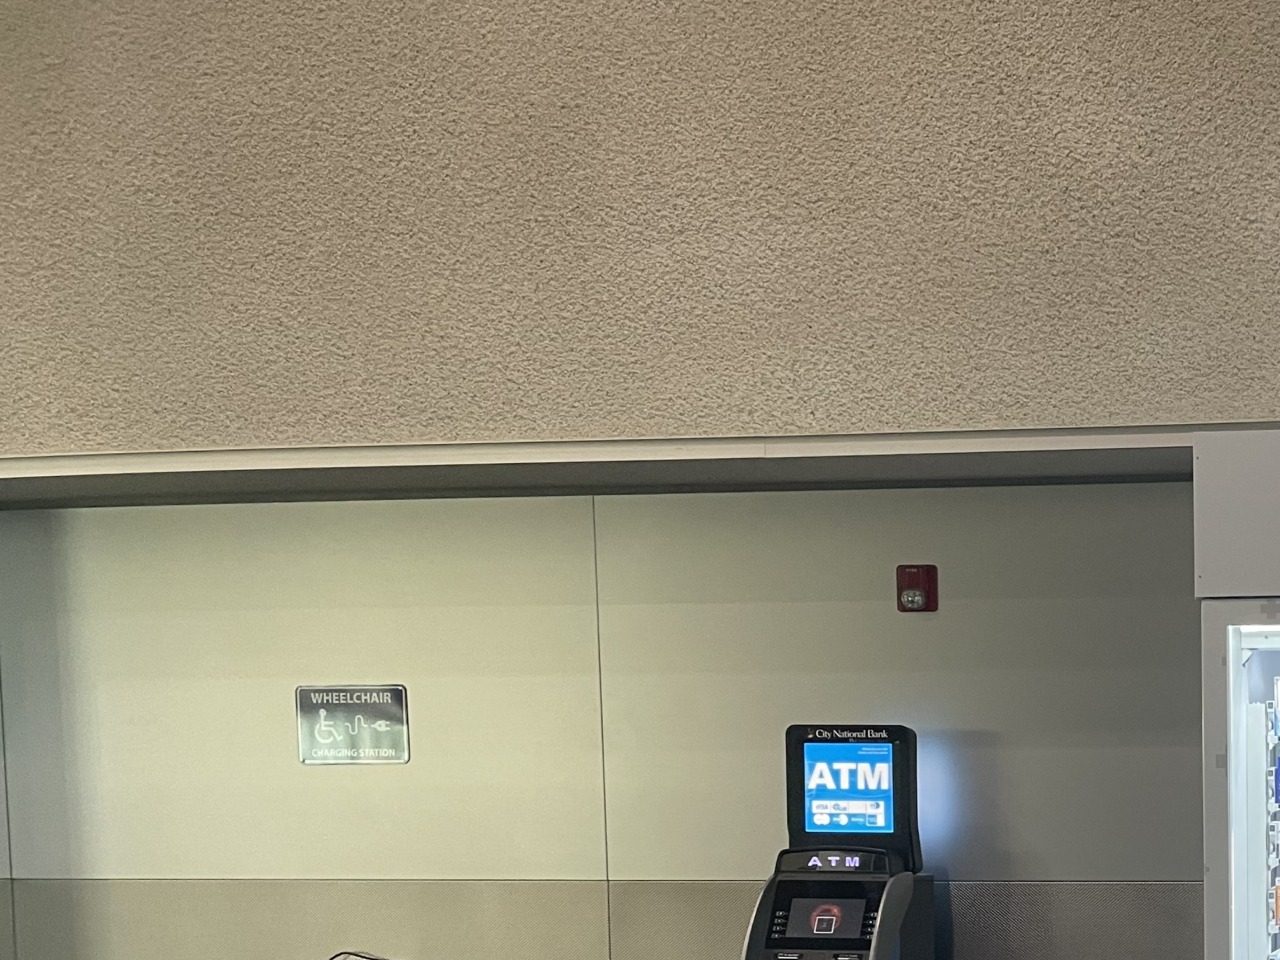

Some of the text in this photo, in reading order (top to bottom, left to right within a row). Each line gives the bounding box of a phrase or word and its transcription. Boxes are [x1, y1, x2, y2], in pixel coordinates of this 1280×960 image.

[310, 692, 392, 704] WHEELCHAIR
[815, 729, 888, 738] City National Bank
[311, 748, 395, 757] CHARGING STATION
[808, 762, 889, 790] ATM
[807, 856, 860, 867] ATM
